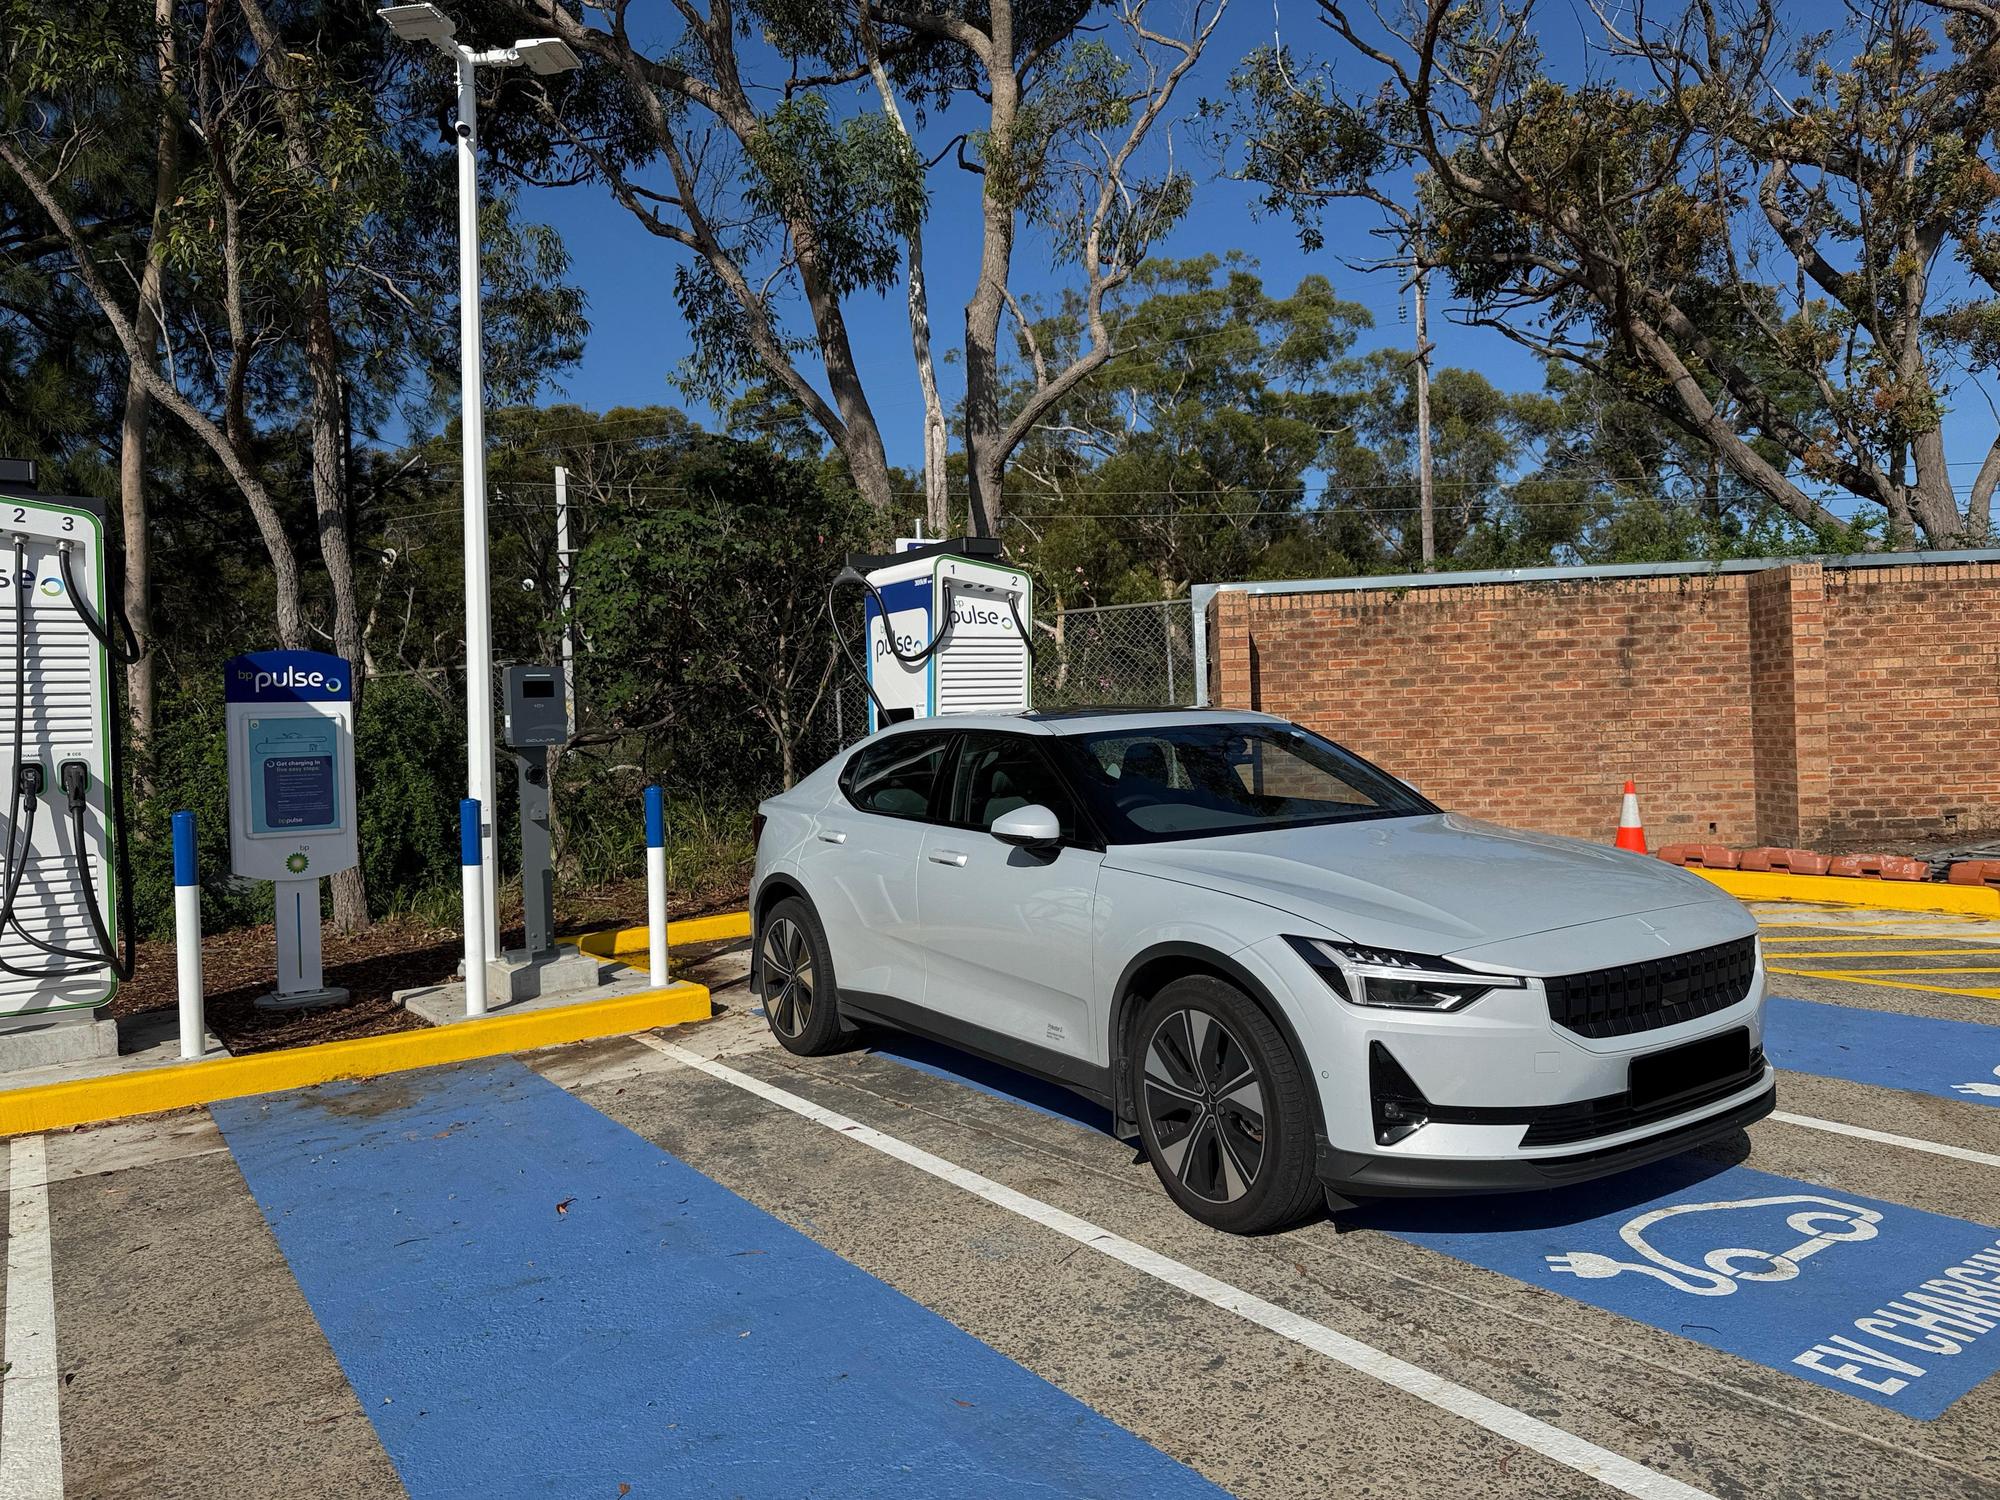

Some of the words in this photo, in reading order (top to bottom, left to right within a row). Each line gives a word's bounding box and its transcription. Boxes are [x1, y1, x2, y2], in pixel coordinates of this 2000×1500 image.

[13, 508, 26, 523] 2
[61, 516, 74, 531] 3
[950, 564, 956, 574] 1
[1011, 576, 1018, 587] 2
[950, 605, 999, 629] pulse
[238, 669, 254, 682] bp
[255, 665, 324, 693] pulse
[288, 759, 314, 767] charging
[1791, 1334, 1928, 1396] EV
